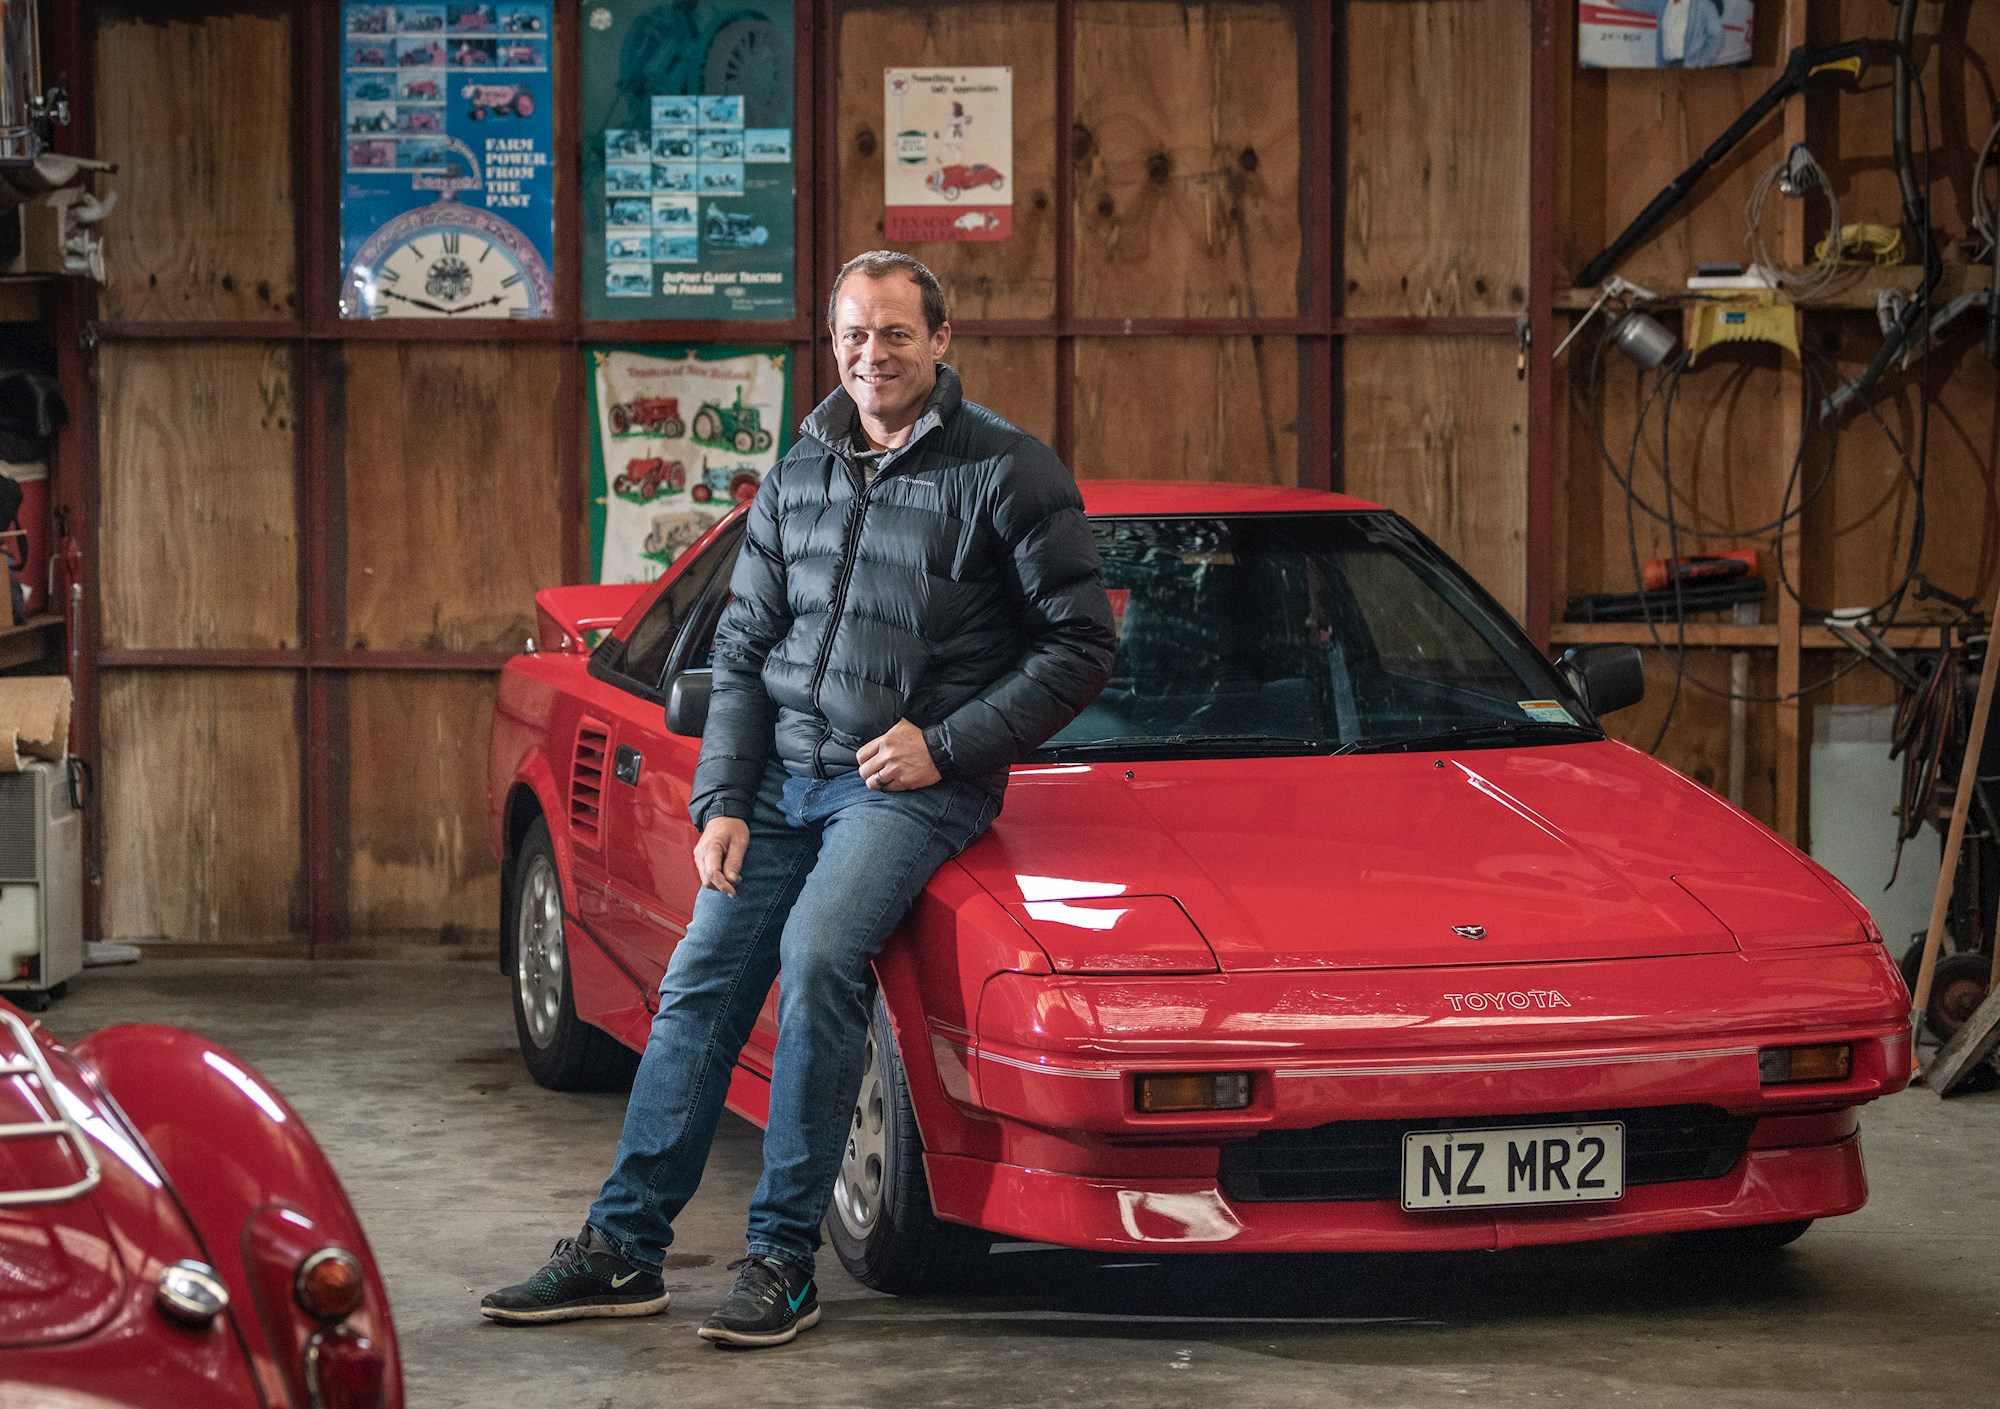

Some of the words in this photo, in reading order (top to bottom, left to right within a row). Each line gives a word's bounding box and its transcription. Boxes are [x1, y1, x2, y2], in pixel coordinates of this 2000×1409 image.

[485, 138, 533, 151] FARM
[485, 152, 546, 166] POWER
[485, 166, 533, 179] FROM
[485, 181, 520, 193] THE
[485, 194, 530, 208] PAST
[1443, 989, 1571, 1011] TOYOTA
[1422, 1144, 1485, 1197] NZ
[1508, 1137, 1605, 1192] MR2
